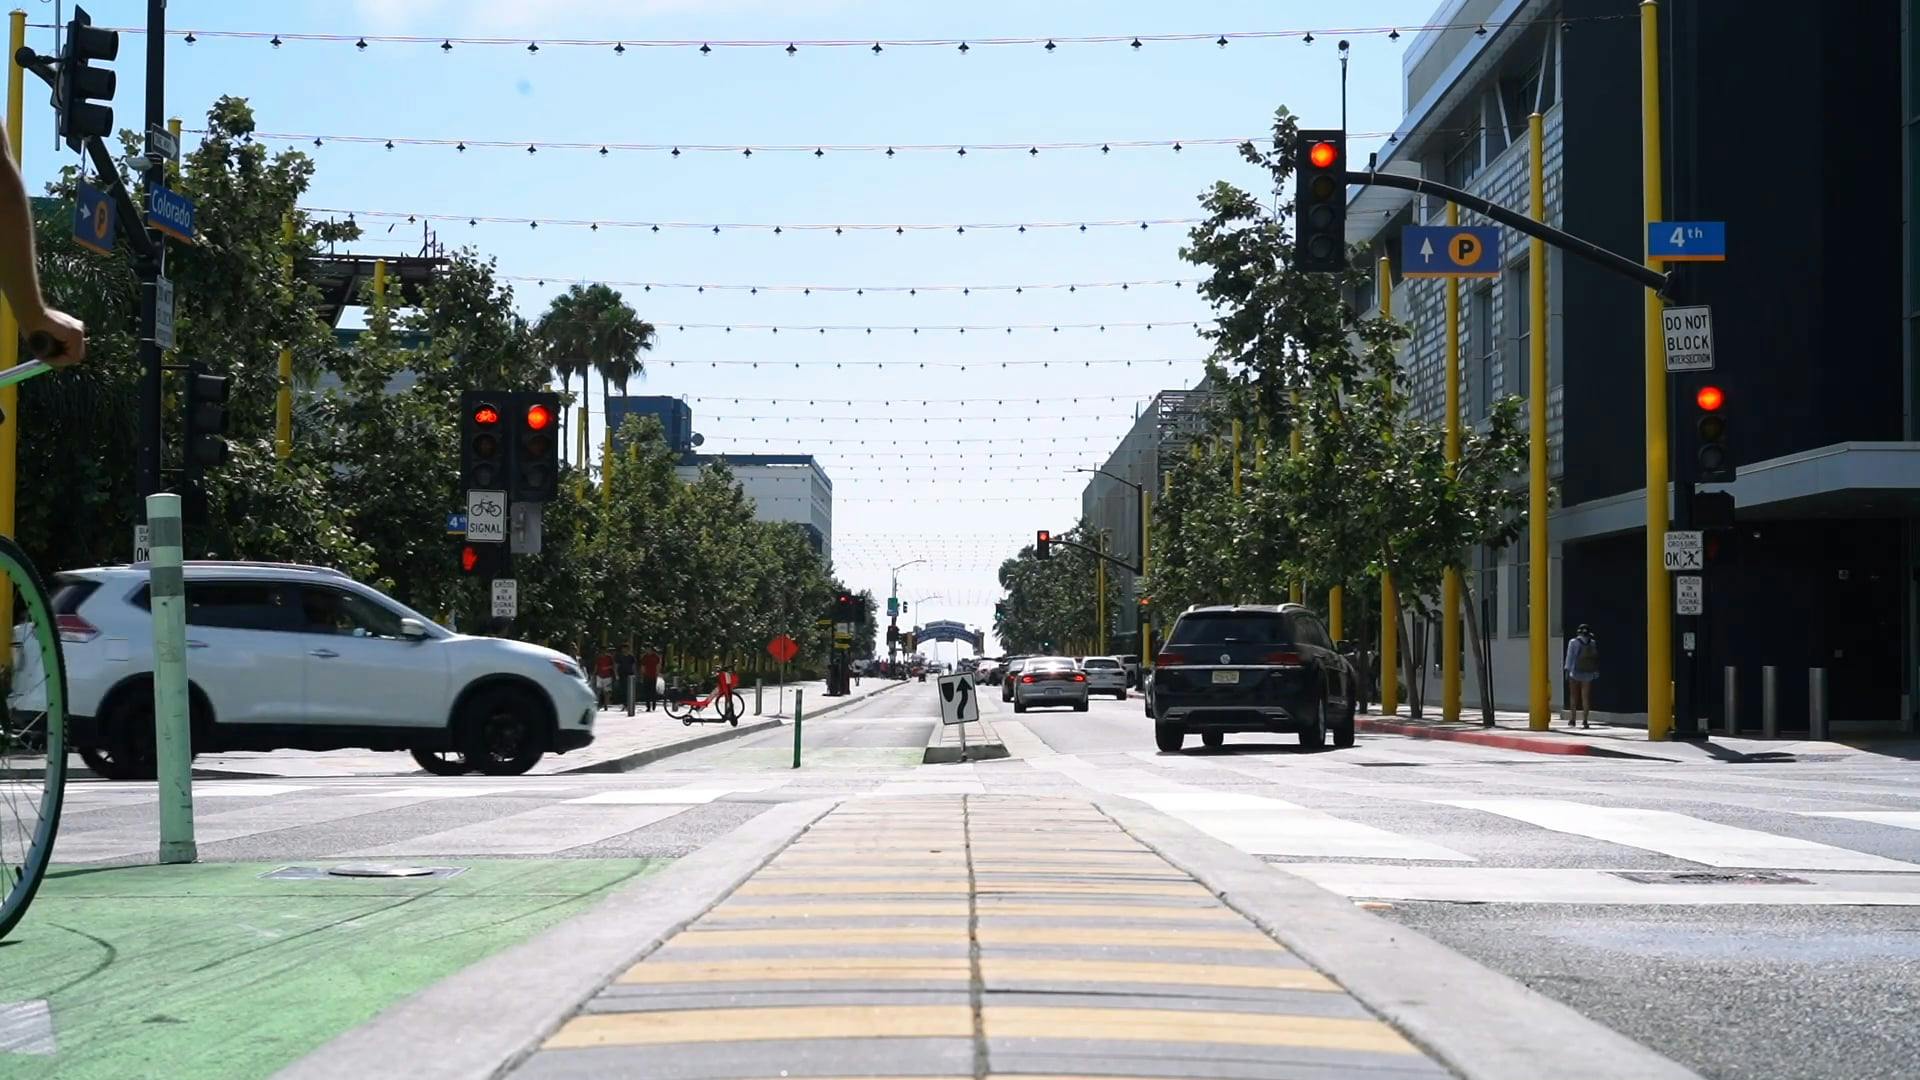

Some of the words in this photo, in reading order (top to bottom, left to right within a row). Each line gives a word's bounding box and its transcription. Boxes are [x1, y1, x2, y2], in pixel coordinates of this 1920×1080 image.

[151, 190, 191, 228] Colorado
[1669, 226, 1703, 248] 4th
[1458, 239, 1475, 260] P
[1665, 316, 1682, 331] DO
[1685, 314, 1707, 330] NOT
[1667, 335, 1709, 351] BLOCK
[469, 522, 502, 534] SIGNAL
[1665, 551, 1680, 566] OK
